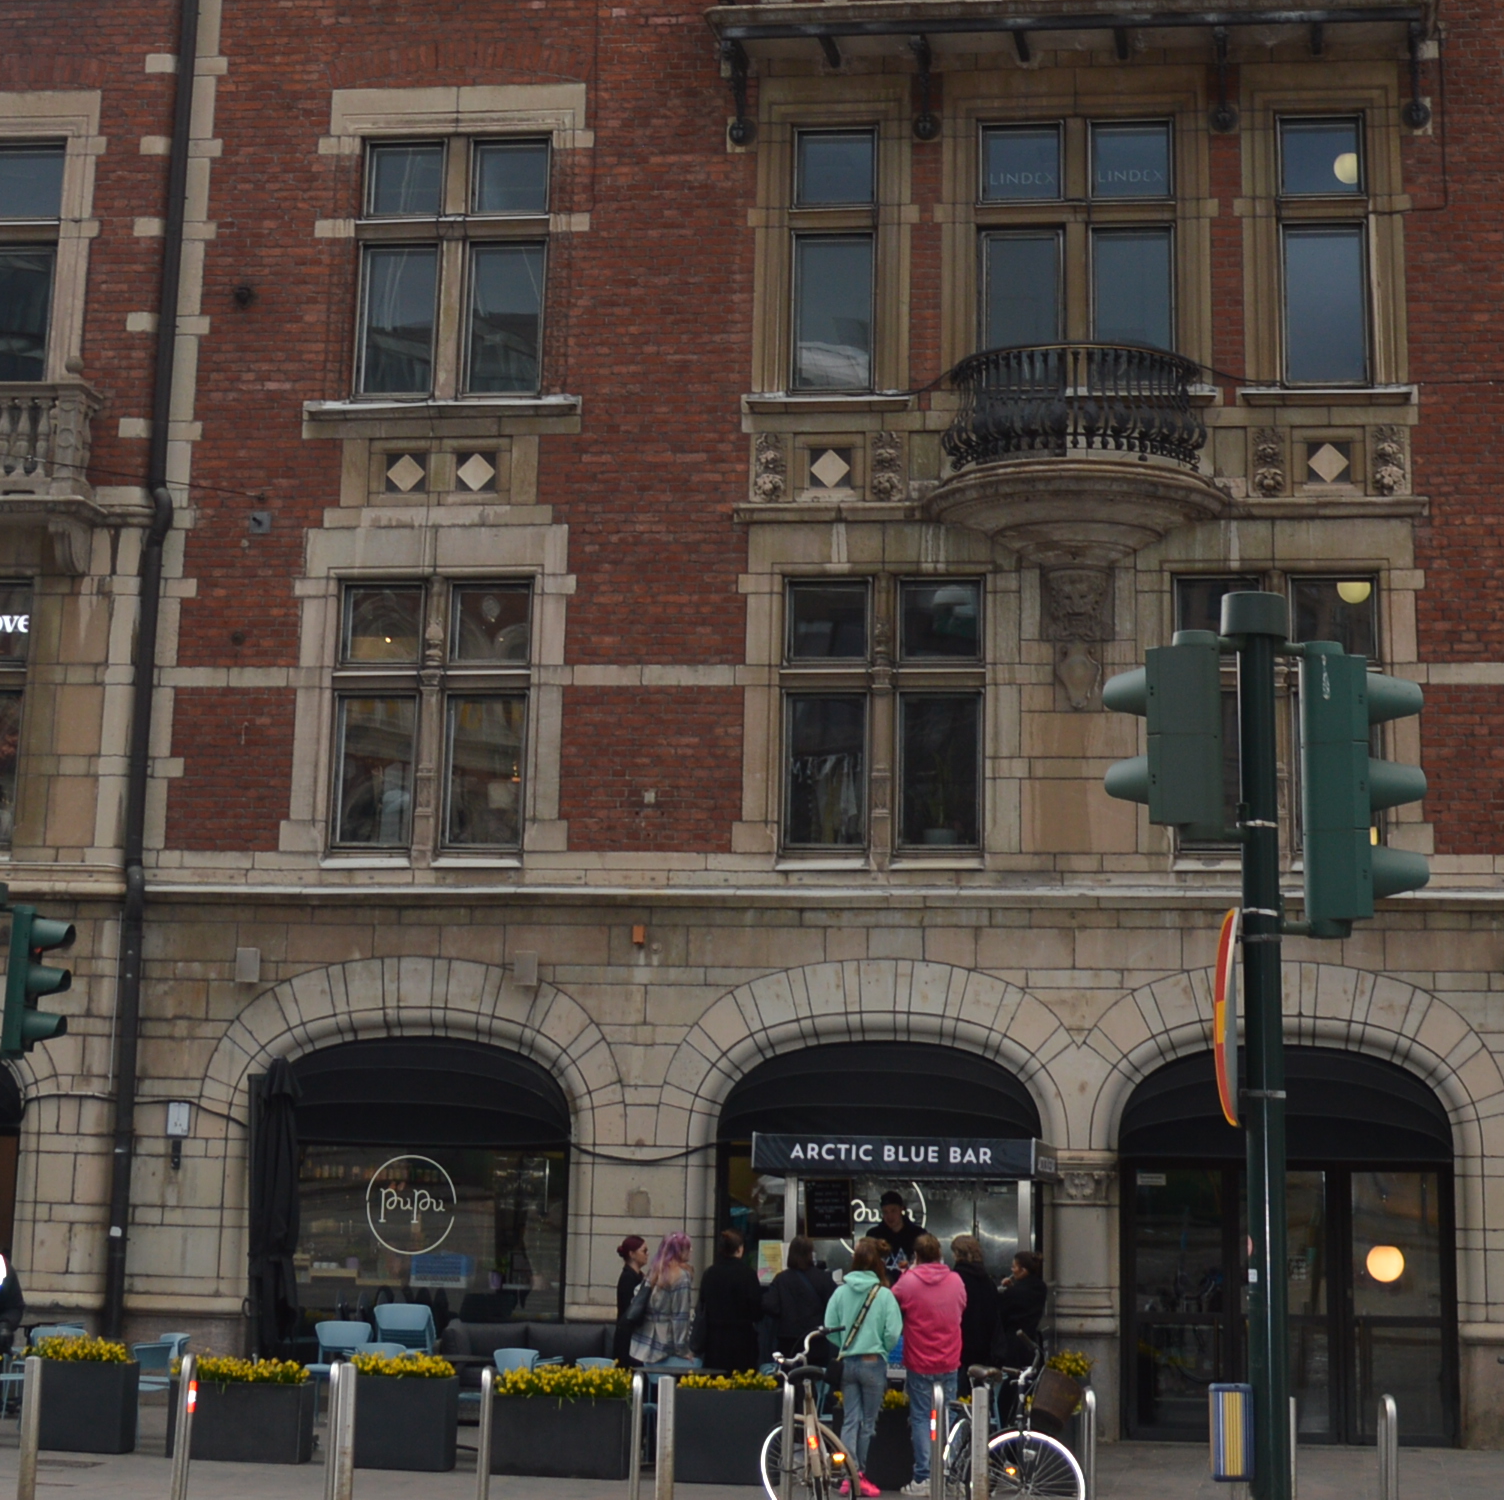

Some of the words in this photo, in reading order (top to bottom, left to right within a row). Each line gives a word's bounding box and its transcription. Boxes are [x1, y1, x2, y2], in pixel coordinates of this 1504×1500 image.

[989, 171, 1057, 186] LINDEX
[1097, 169, 1164, 184] LINDEX
[790, 1143, 874, 1161] ARCTIC
[883, 1144, 939, 1163] BLUE
[949, 1146, 992, 1164] BAR
[378, 1187, 446, 1224] pupu
